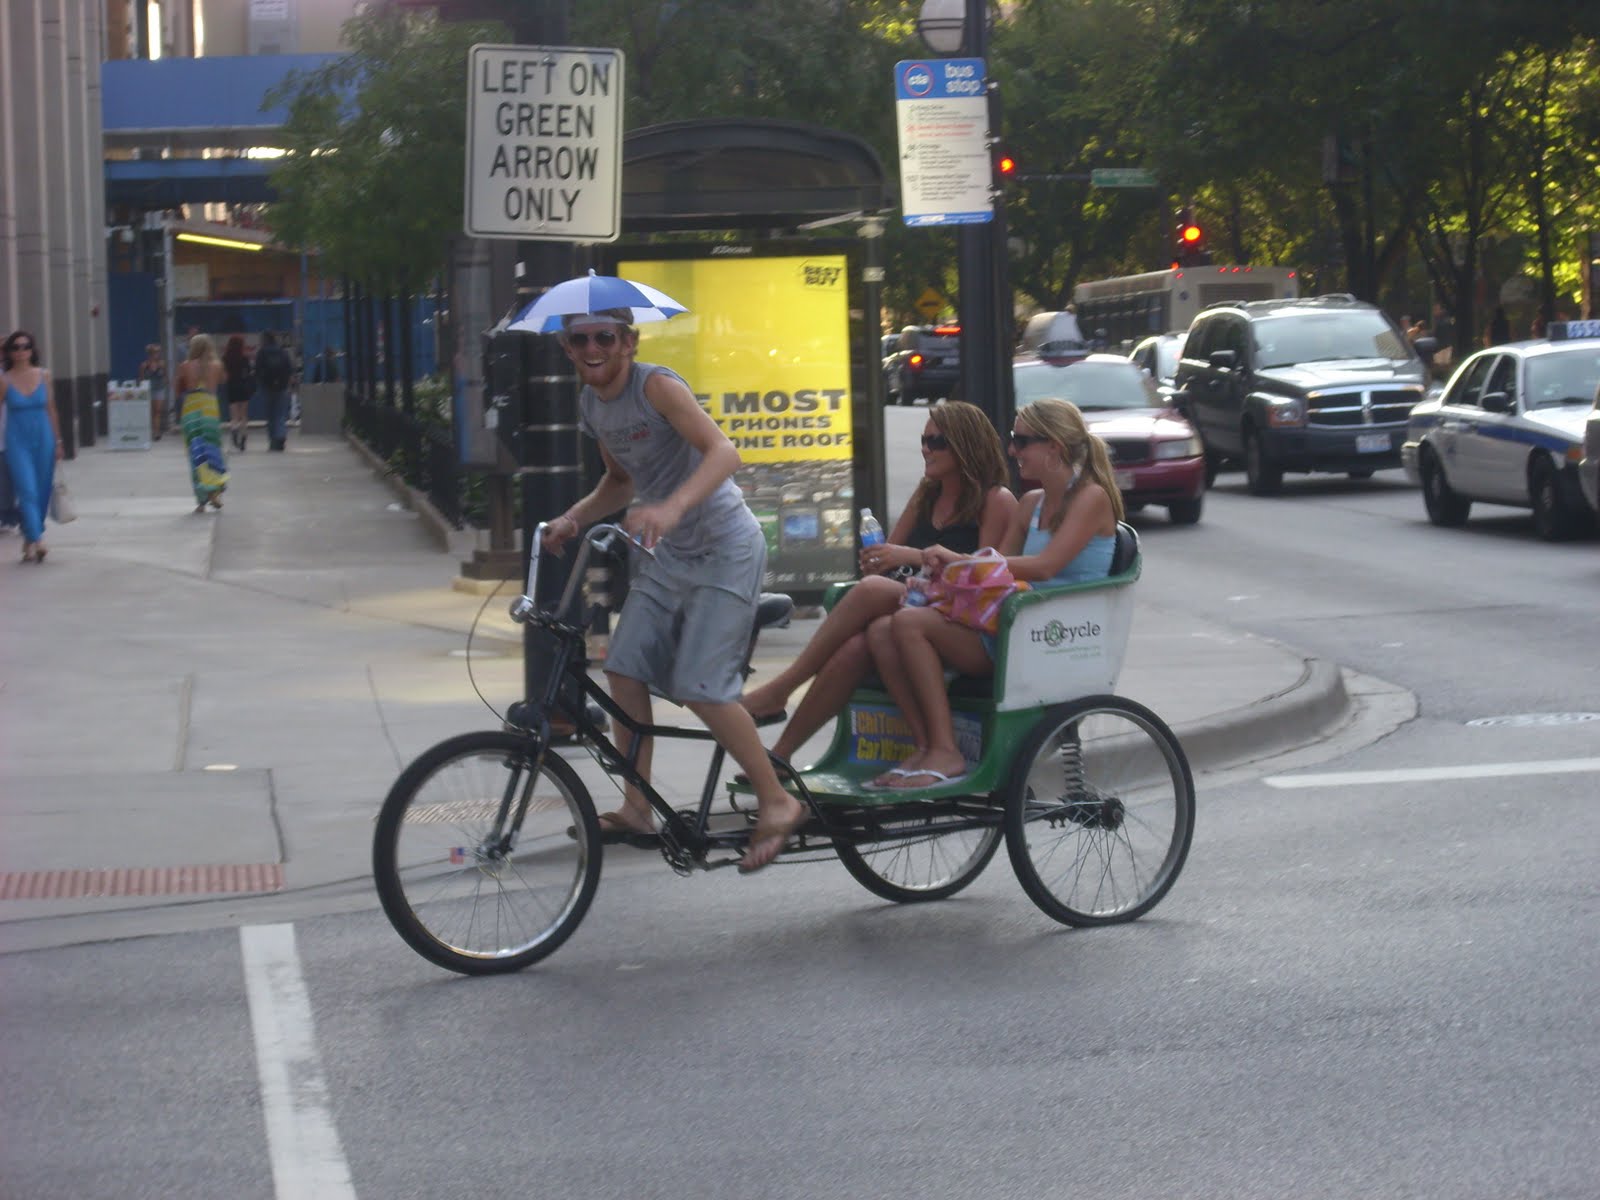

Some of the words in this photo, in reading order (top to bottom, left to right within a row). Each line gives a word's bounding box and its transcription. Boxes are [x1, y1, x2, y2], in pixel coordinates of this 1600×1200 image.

[482, 59, 557, 94] LEFT
[569, 62, 610, 97] ON
[944, 63, 975, 78] bus
[945, 79, 981, 96] stop
[496, 102, 594, 138] GREEN
[489, 143, 599, 181] ARROW
[504, 186, 581, 222] ONLY
[804, 266, 841, 277] BEST
[805, 276, 838, 286] BUY
[723, 389, 846, 414] MOST
[731, 415, 832, 432] PHONES
